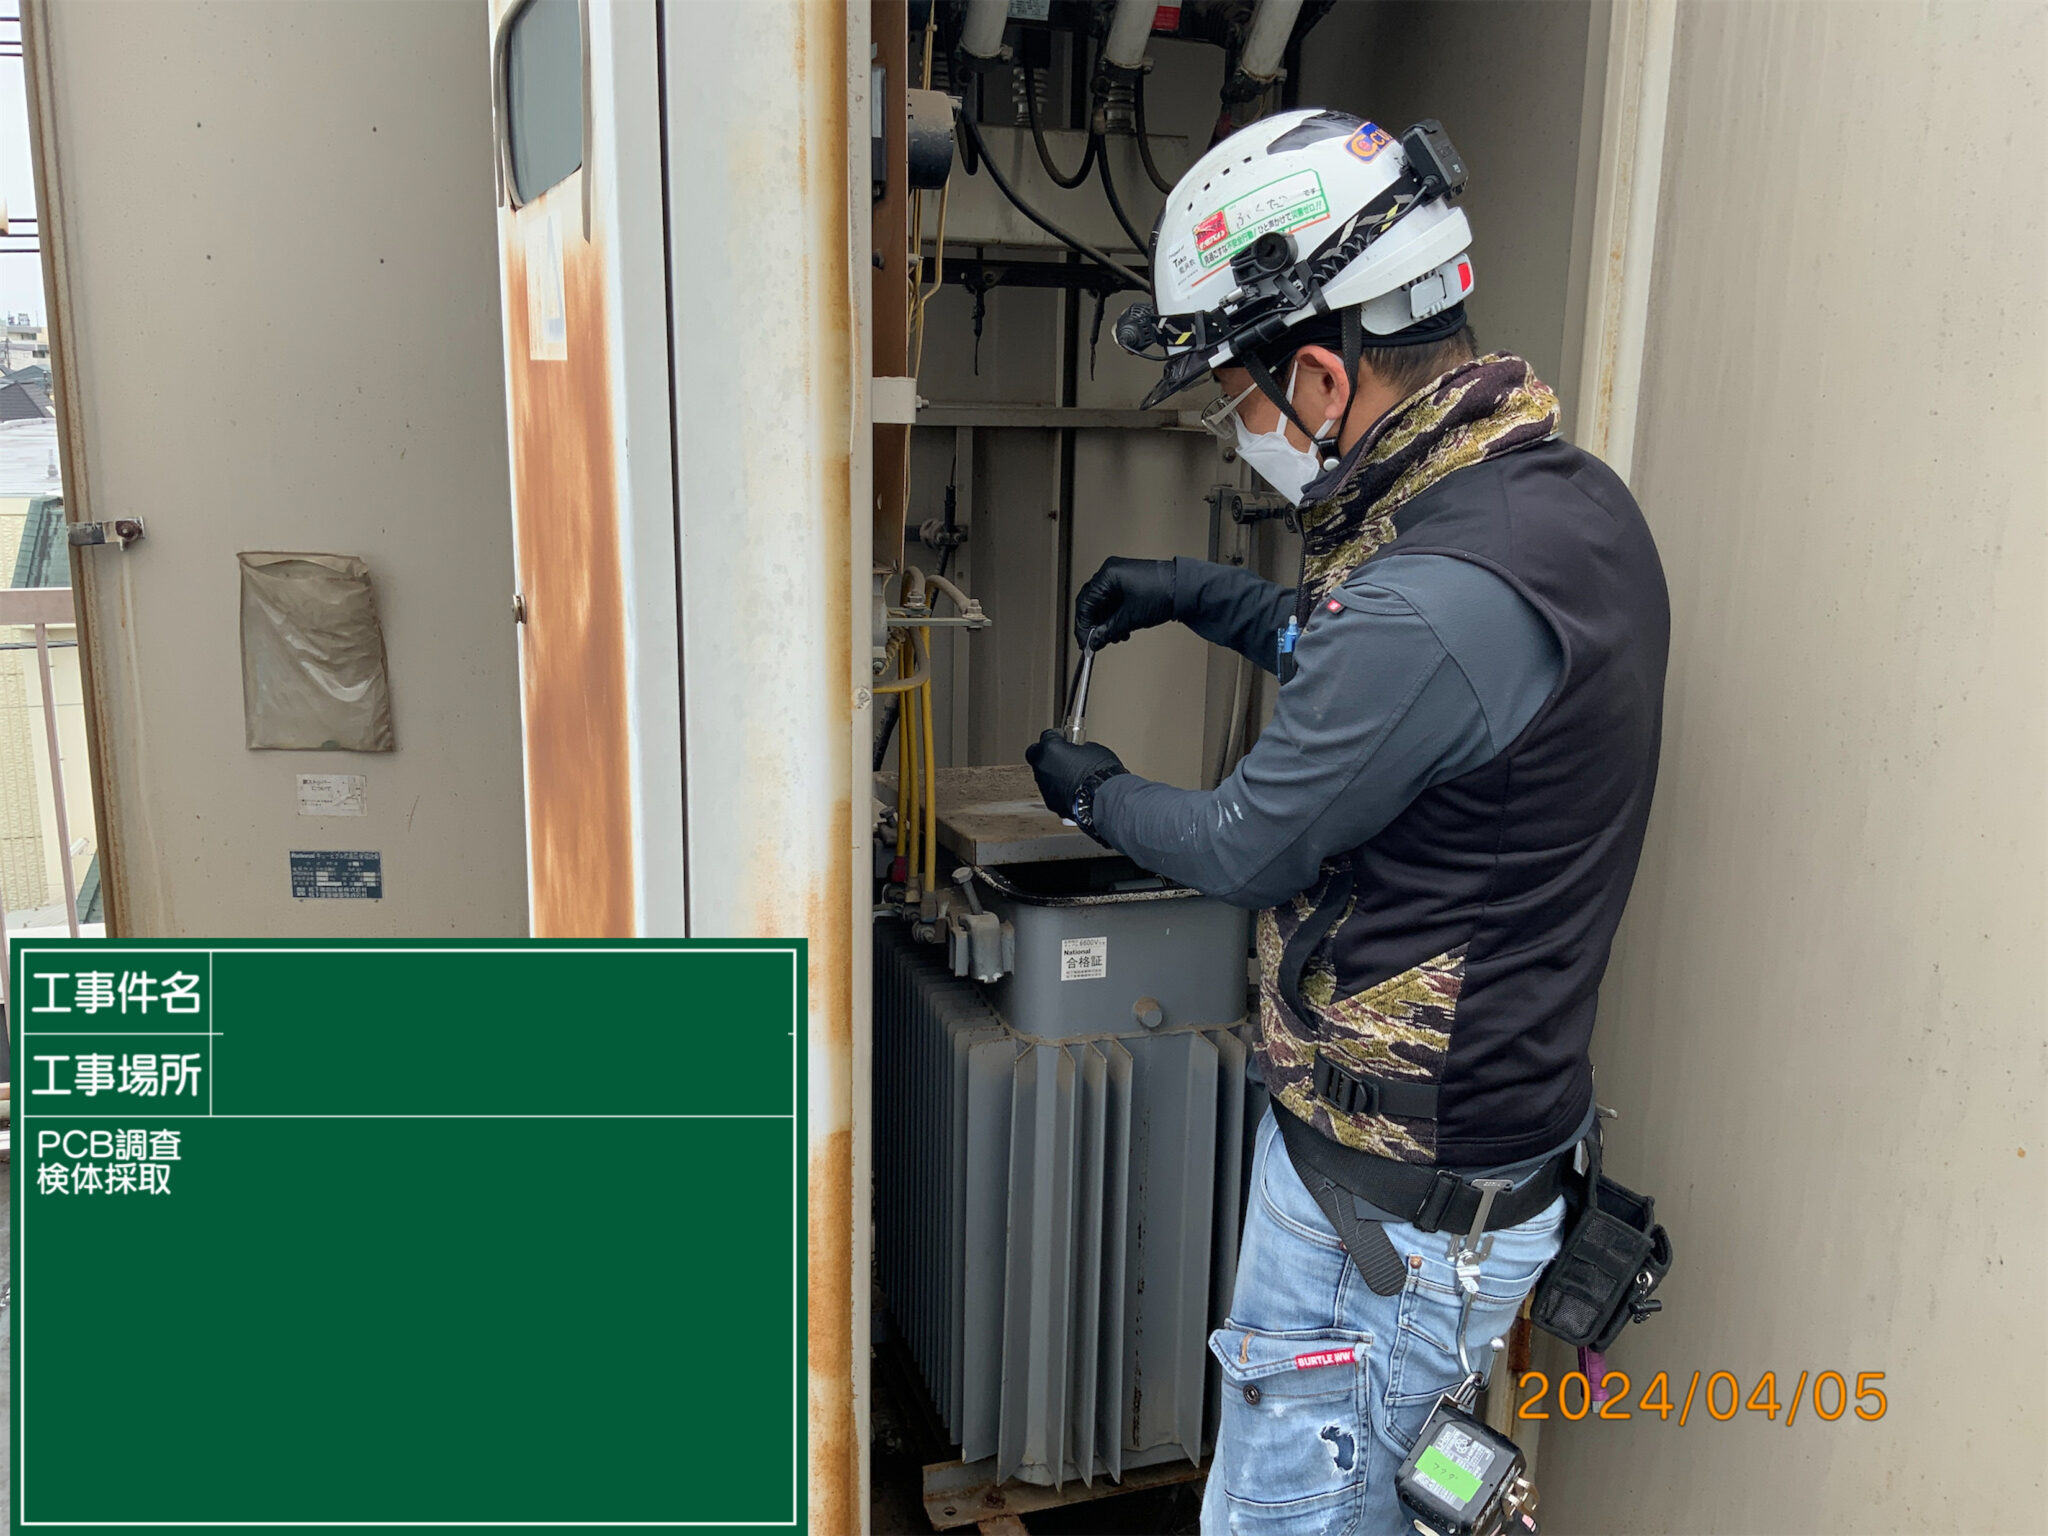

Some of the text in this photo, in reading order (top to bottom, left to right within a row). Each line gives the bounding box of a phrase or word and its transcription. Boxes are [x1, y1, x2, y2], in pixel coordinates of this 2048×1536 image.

[1063, 948, 1091, 956] National
[1066, 955, 1103, 969] 合格証
[1297, 1353, 1333, 1367] BURTLE
